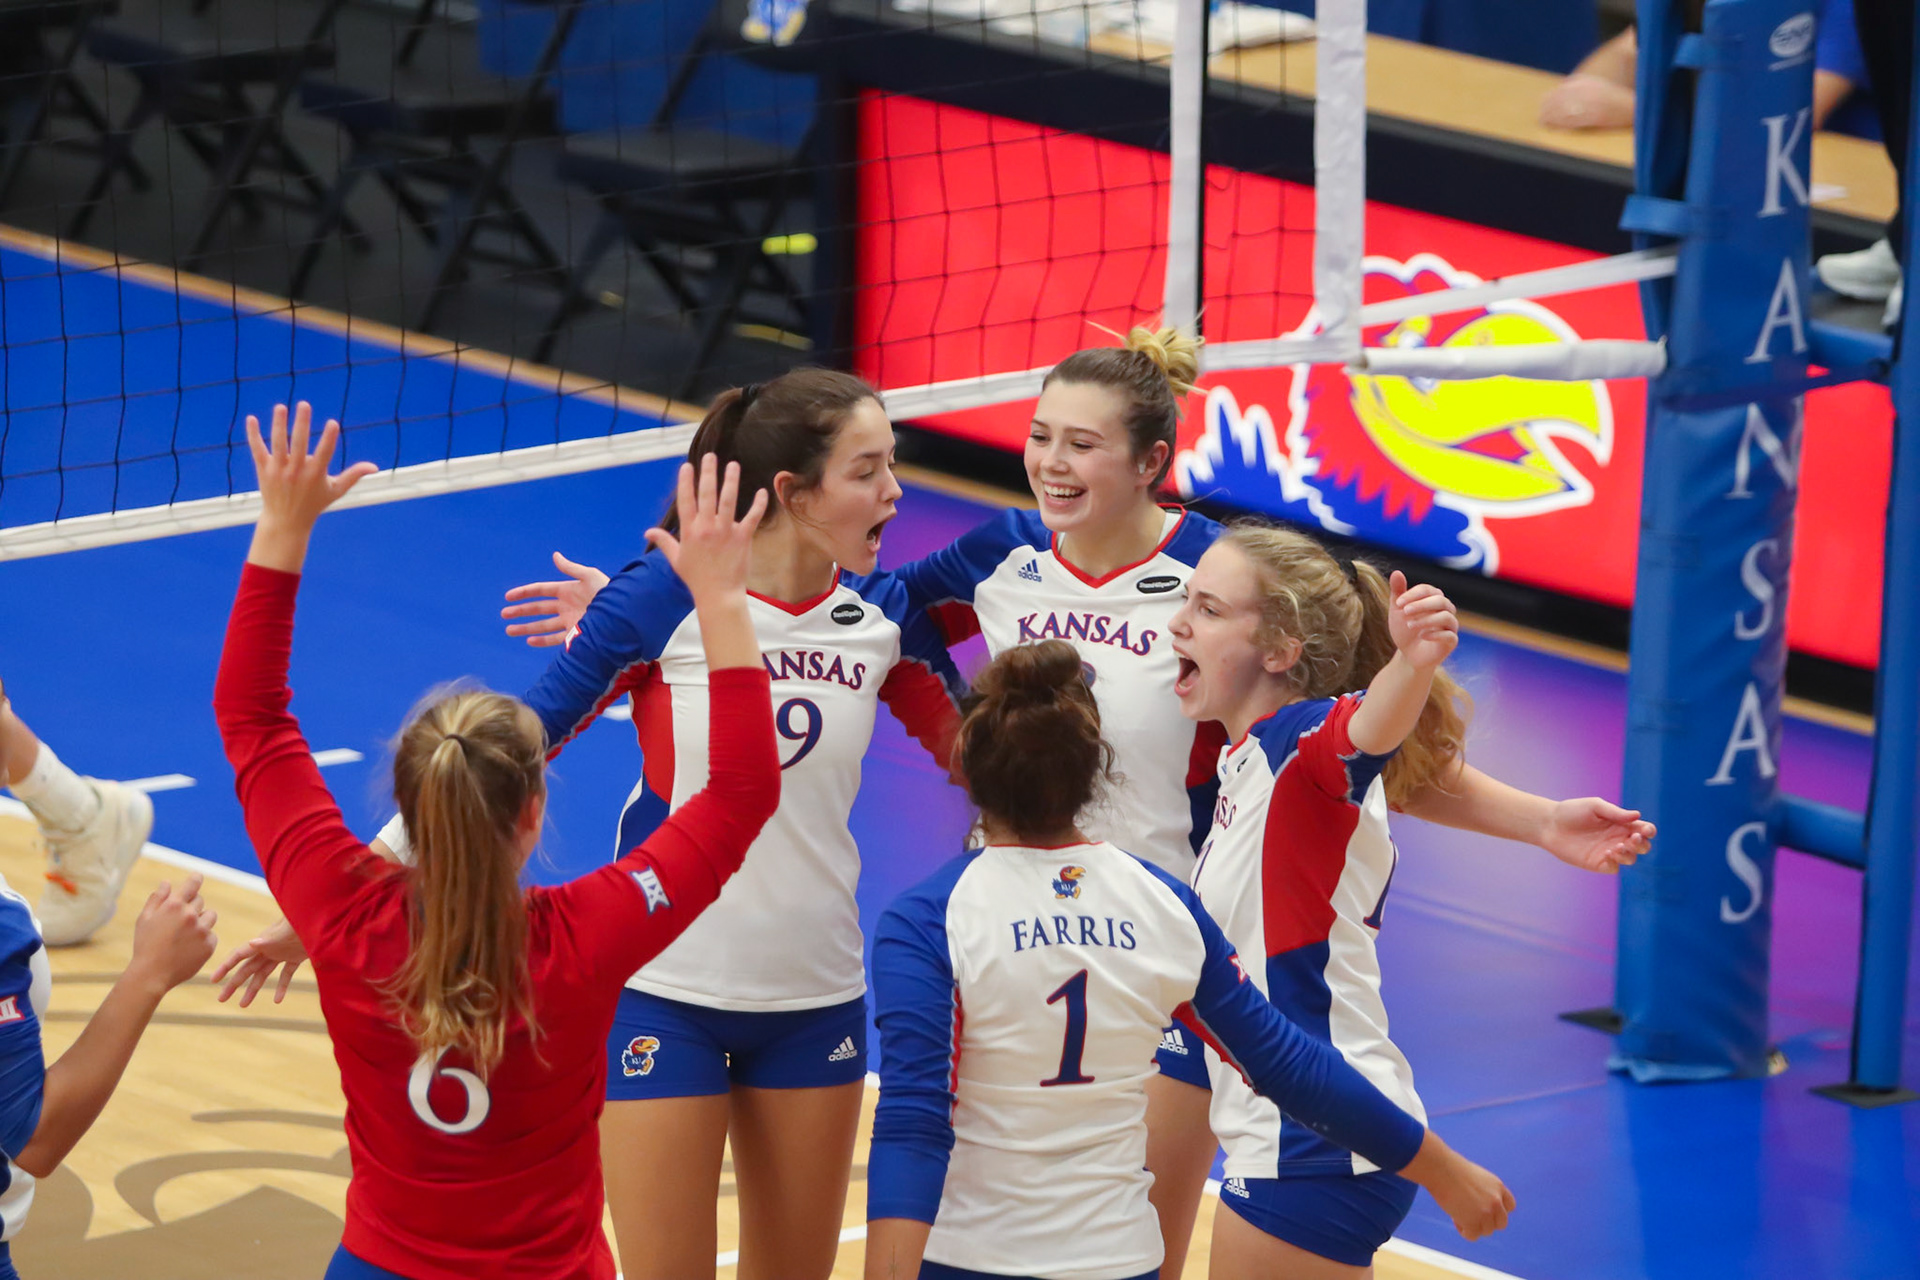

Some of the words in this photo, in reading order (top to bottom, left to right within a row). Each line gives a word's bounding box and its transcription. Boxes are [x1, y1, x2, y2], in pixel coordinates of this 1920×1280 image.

[1704, 105, 1813, 925] KANSAS
[1017, 570, 1042, 583] adidas
[1017, 612, 1158, 657] KANSAS
[762, 651, 866, 690] NSAS
[776, 697, 823, 771] 9
[1010, 915, 1137, 953] FARRIS
[1039, 968, 1096, 1087] 1
[828, 1049, 858, 1062] adidas
[1158, 1039, 1189, 1056] adidas
[406, 1045, 492, 1135] 6
[1224, 1182, 1250, 1199] adidas
